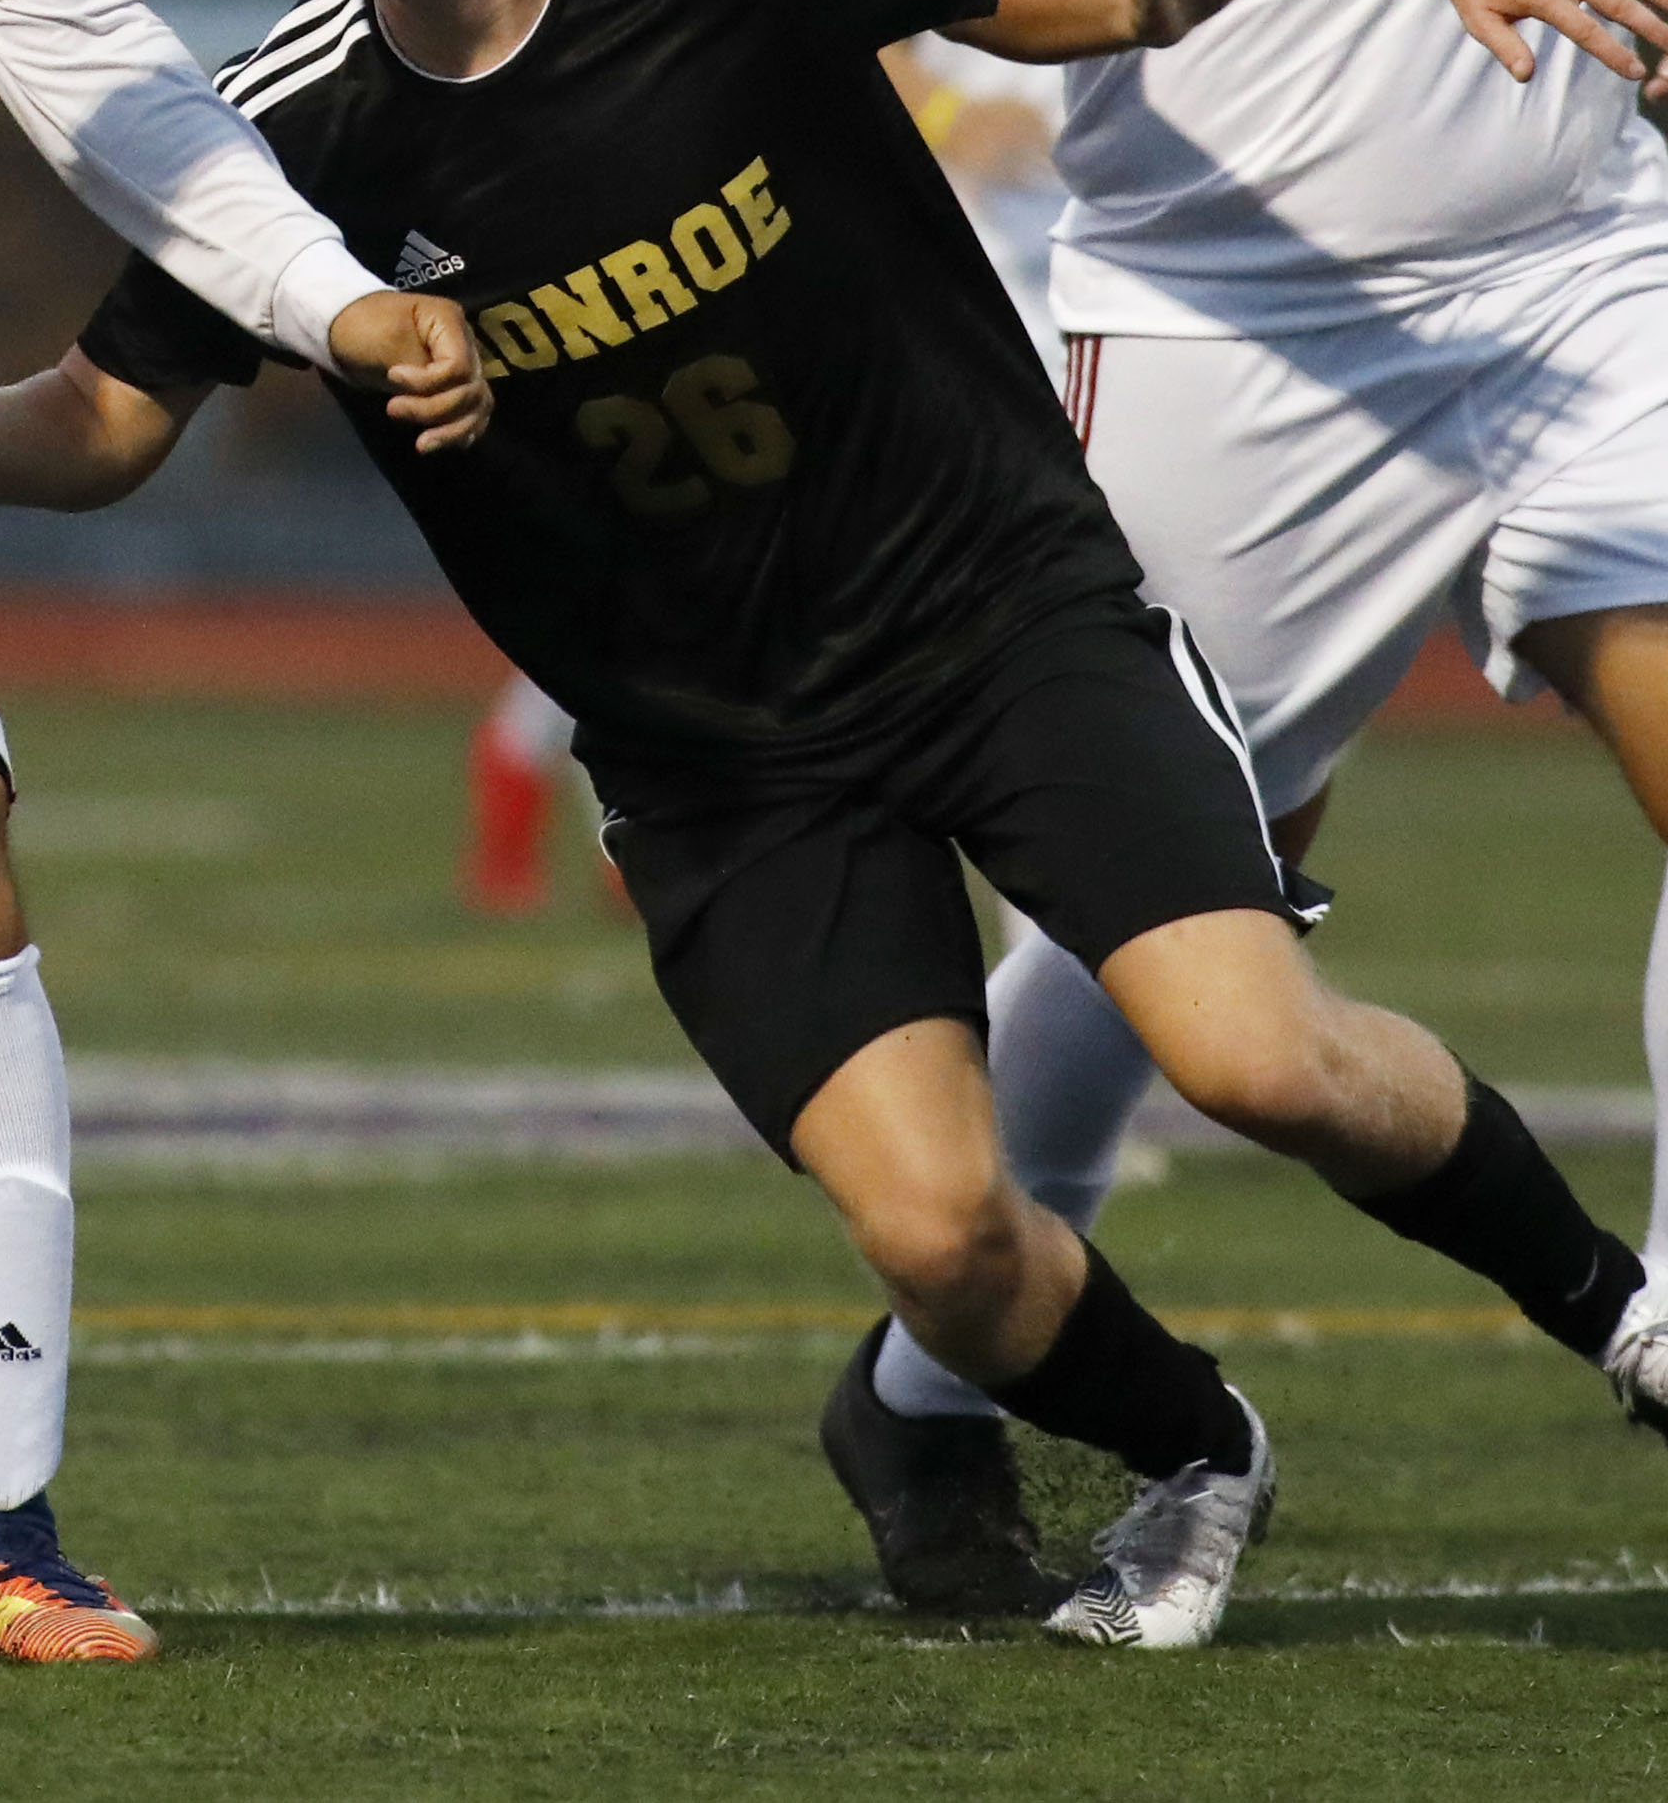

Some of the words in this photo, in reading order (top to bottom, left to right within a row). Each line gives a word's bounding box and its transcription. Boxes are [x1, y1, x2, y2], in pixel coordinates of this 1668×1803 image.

[394, 254, 466, 292] adidas
[478, 154, 793, 380] ONROE
[575, 353, 798, 516] 26
